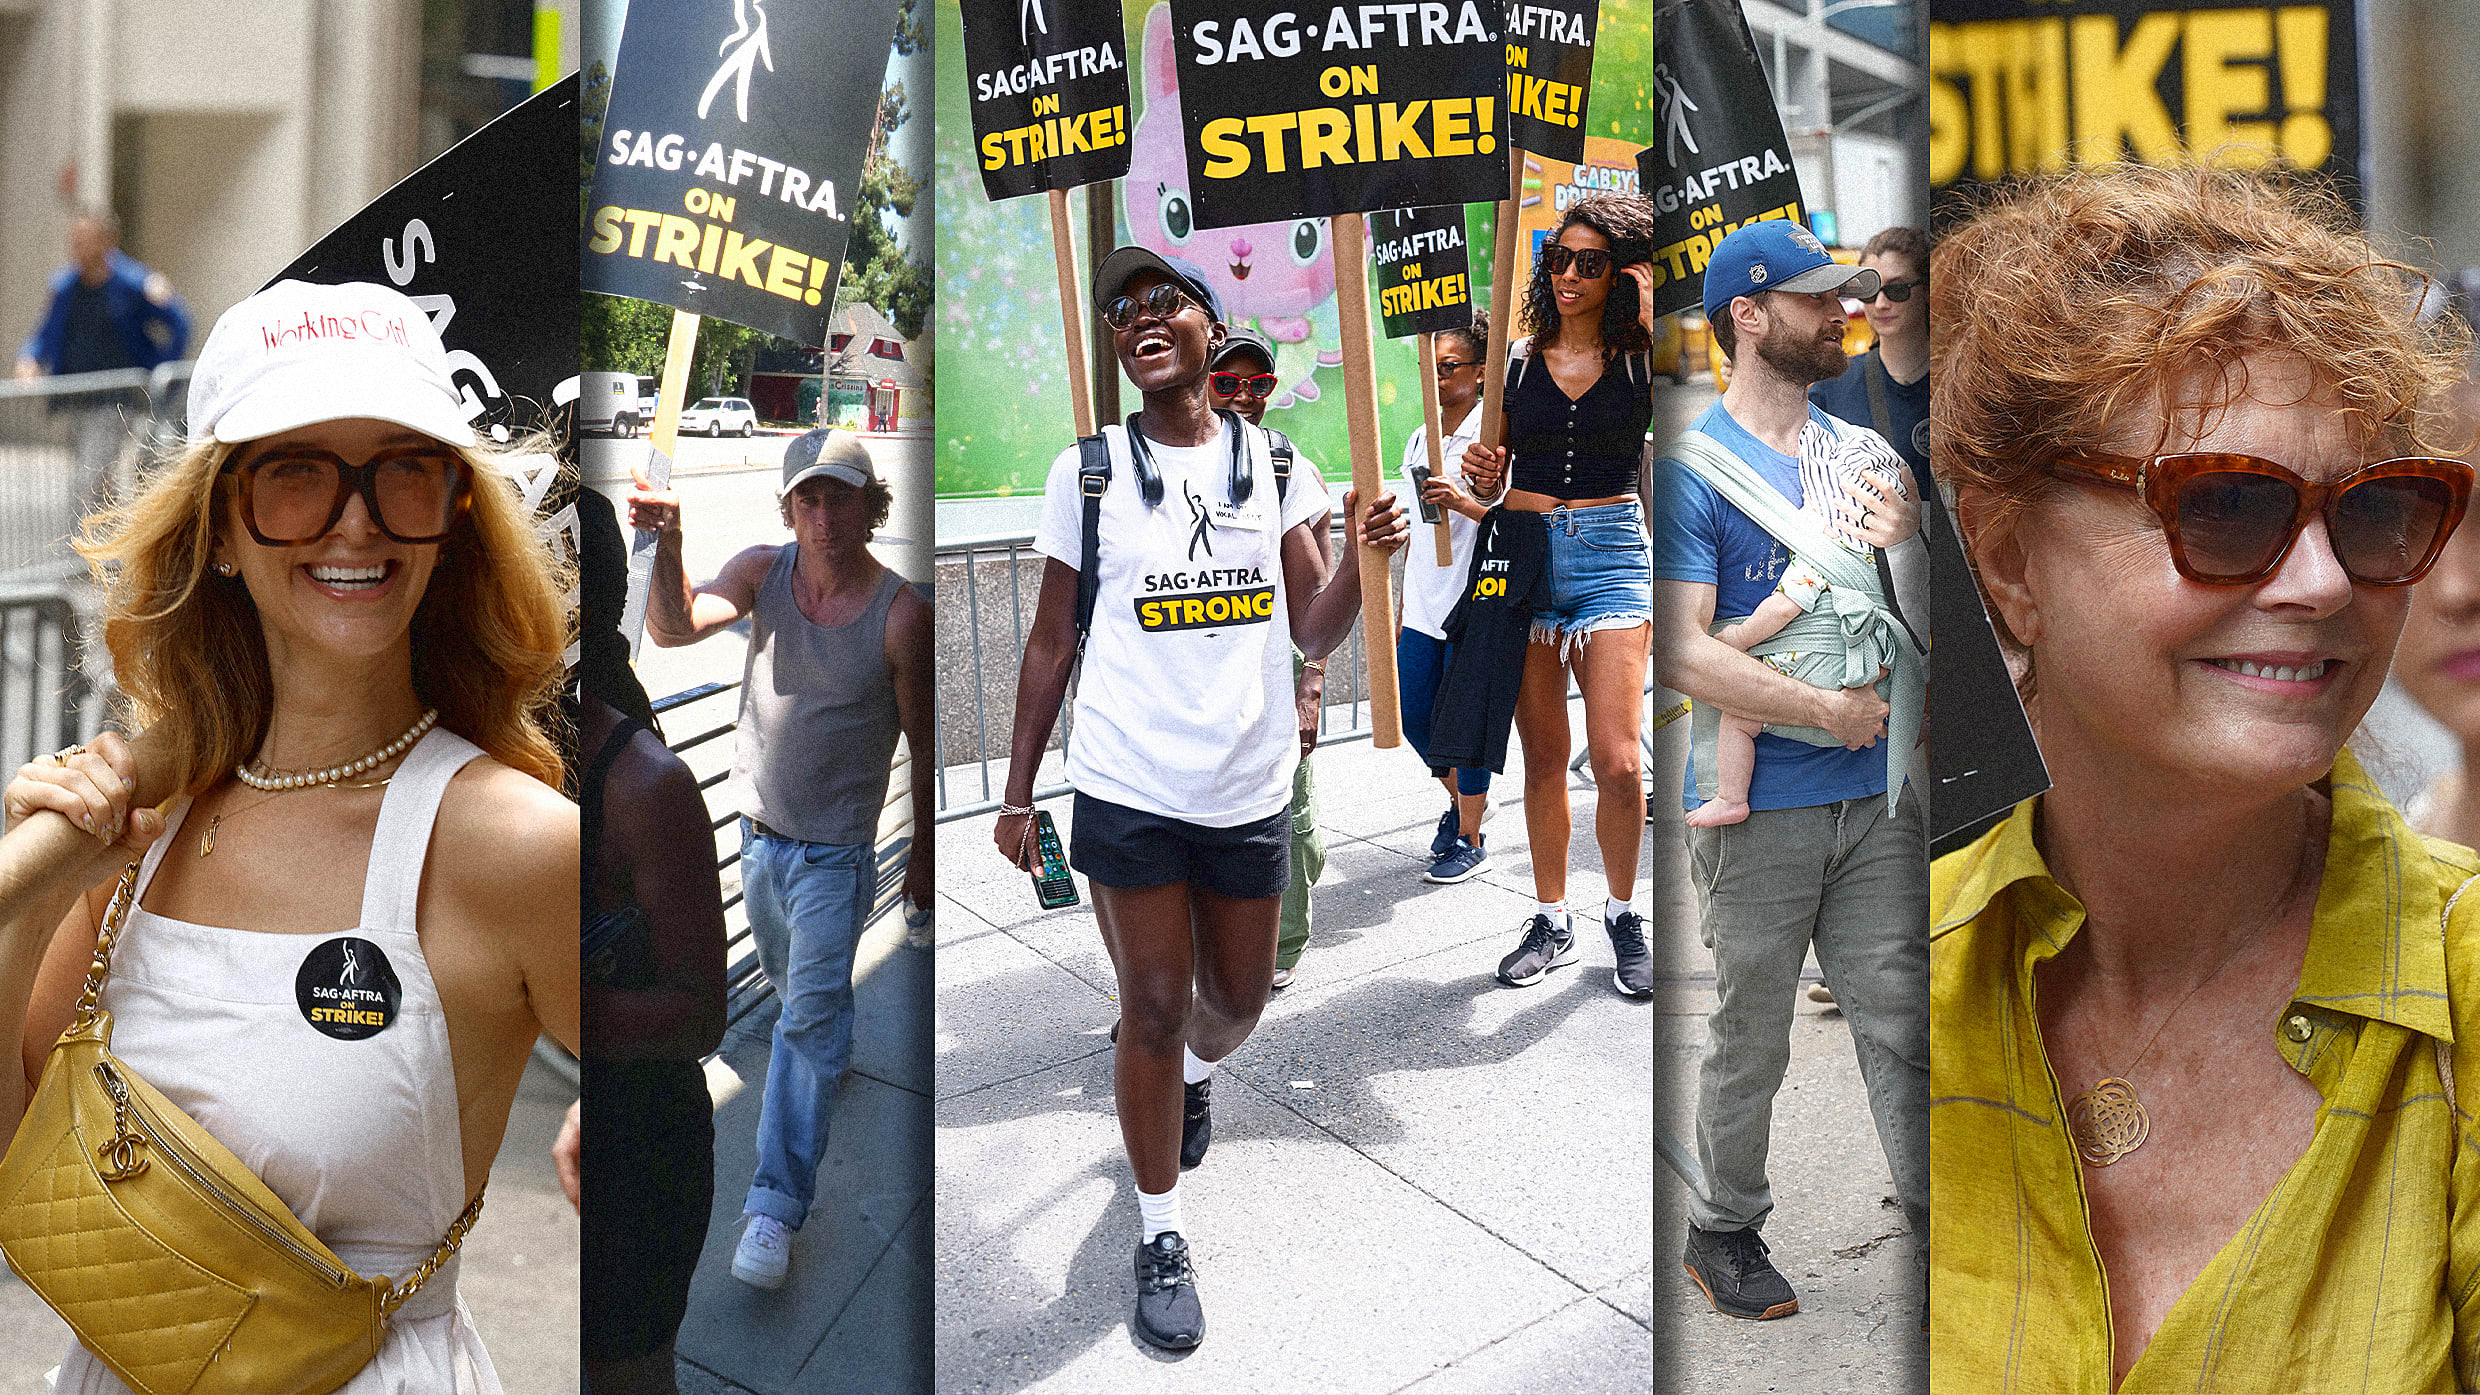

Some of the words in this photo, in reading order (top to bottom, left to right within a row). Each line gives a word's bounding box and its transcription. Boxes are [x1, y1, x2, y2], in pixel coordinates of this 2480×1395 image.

[1505, 43, 1528, 69] ON
[1319, 64, 1379, 98] ON
[1032, 93, 1060, 118] ON
[1507, 72, 1583, 129] IKE!
[981, 104, 1126, 171] STRIKE!
[1200, 96, 1496, 179] STRIKE!
[684, 187, 737, 223] ON
[1689, 203, 1724, 231] ON
[588, 205, 830, 307] STRIKE!
[1402, 262, 1422, 281] ON
[1381, 273, 1467, 318] STRIKE!
[262, 311, 357, 356] Working
[360, 310, 410, 348] Girl
[1141, 591, 1274, 627] STRONG
[310, 1007, 385, 1027] STRIKE!
[340, 1000, 356, 1010] ON
